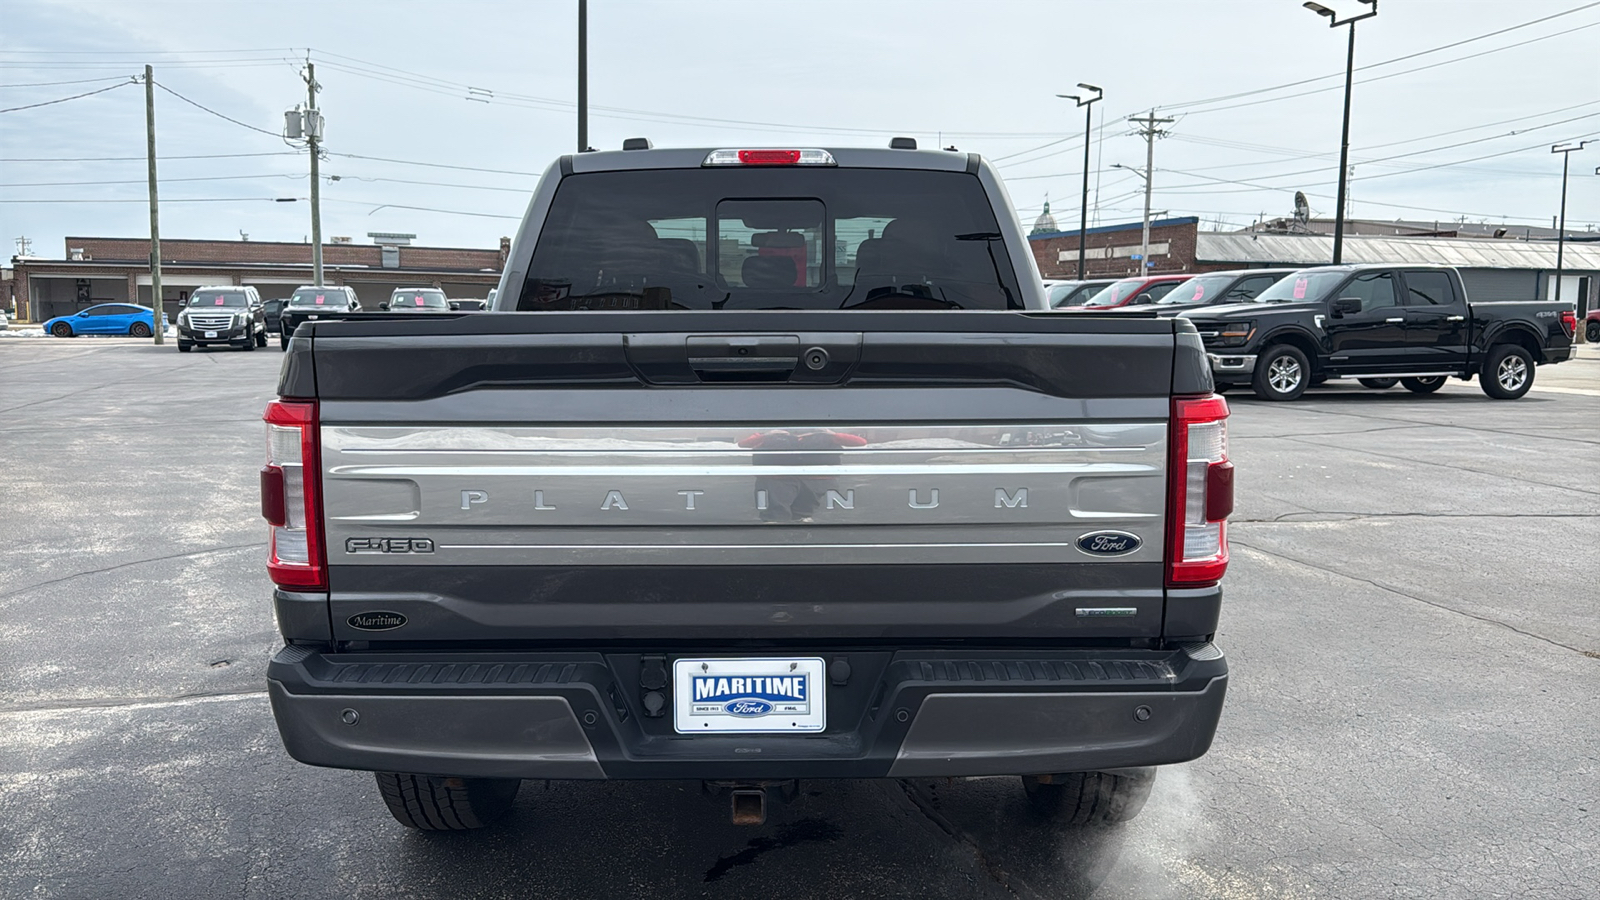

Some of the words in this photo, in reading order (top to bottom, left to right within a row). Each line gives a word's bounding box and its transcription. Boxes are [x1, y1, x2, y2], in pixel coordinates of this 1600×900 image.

[460, 488, 1029, 510] PLATINUM
[345, 537, 435, 554] F-150
[1091, 535, 1128, 551] Ford
[354, 614, 402, 627] Maritime
[695, 677, 805, 701] MARITIME
[733, 702, 764, 713] Ford
